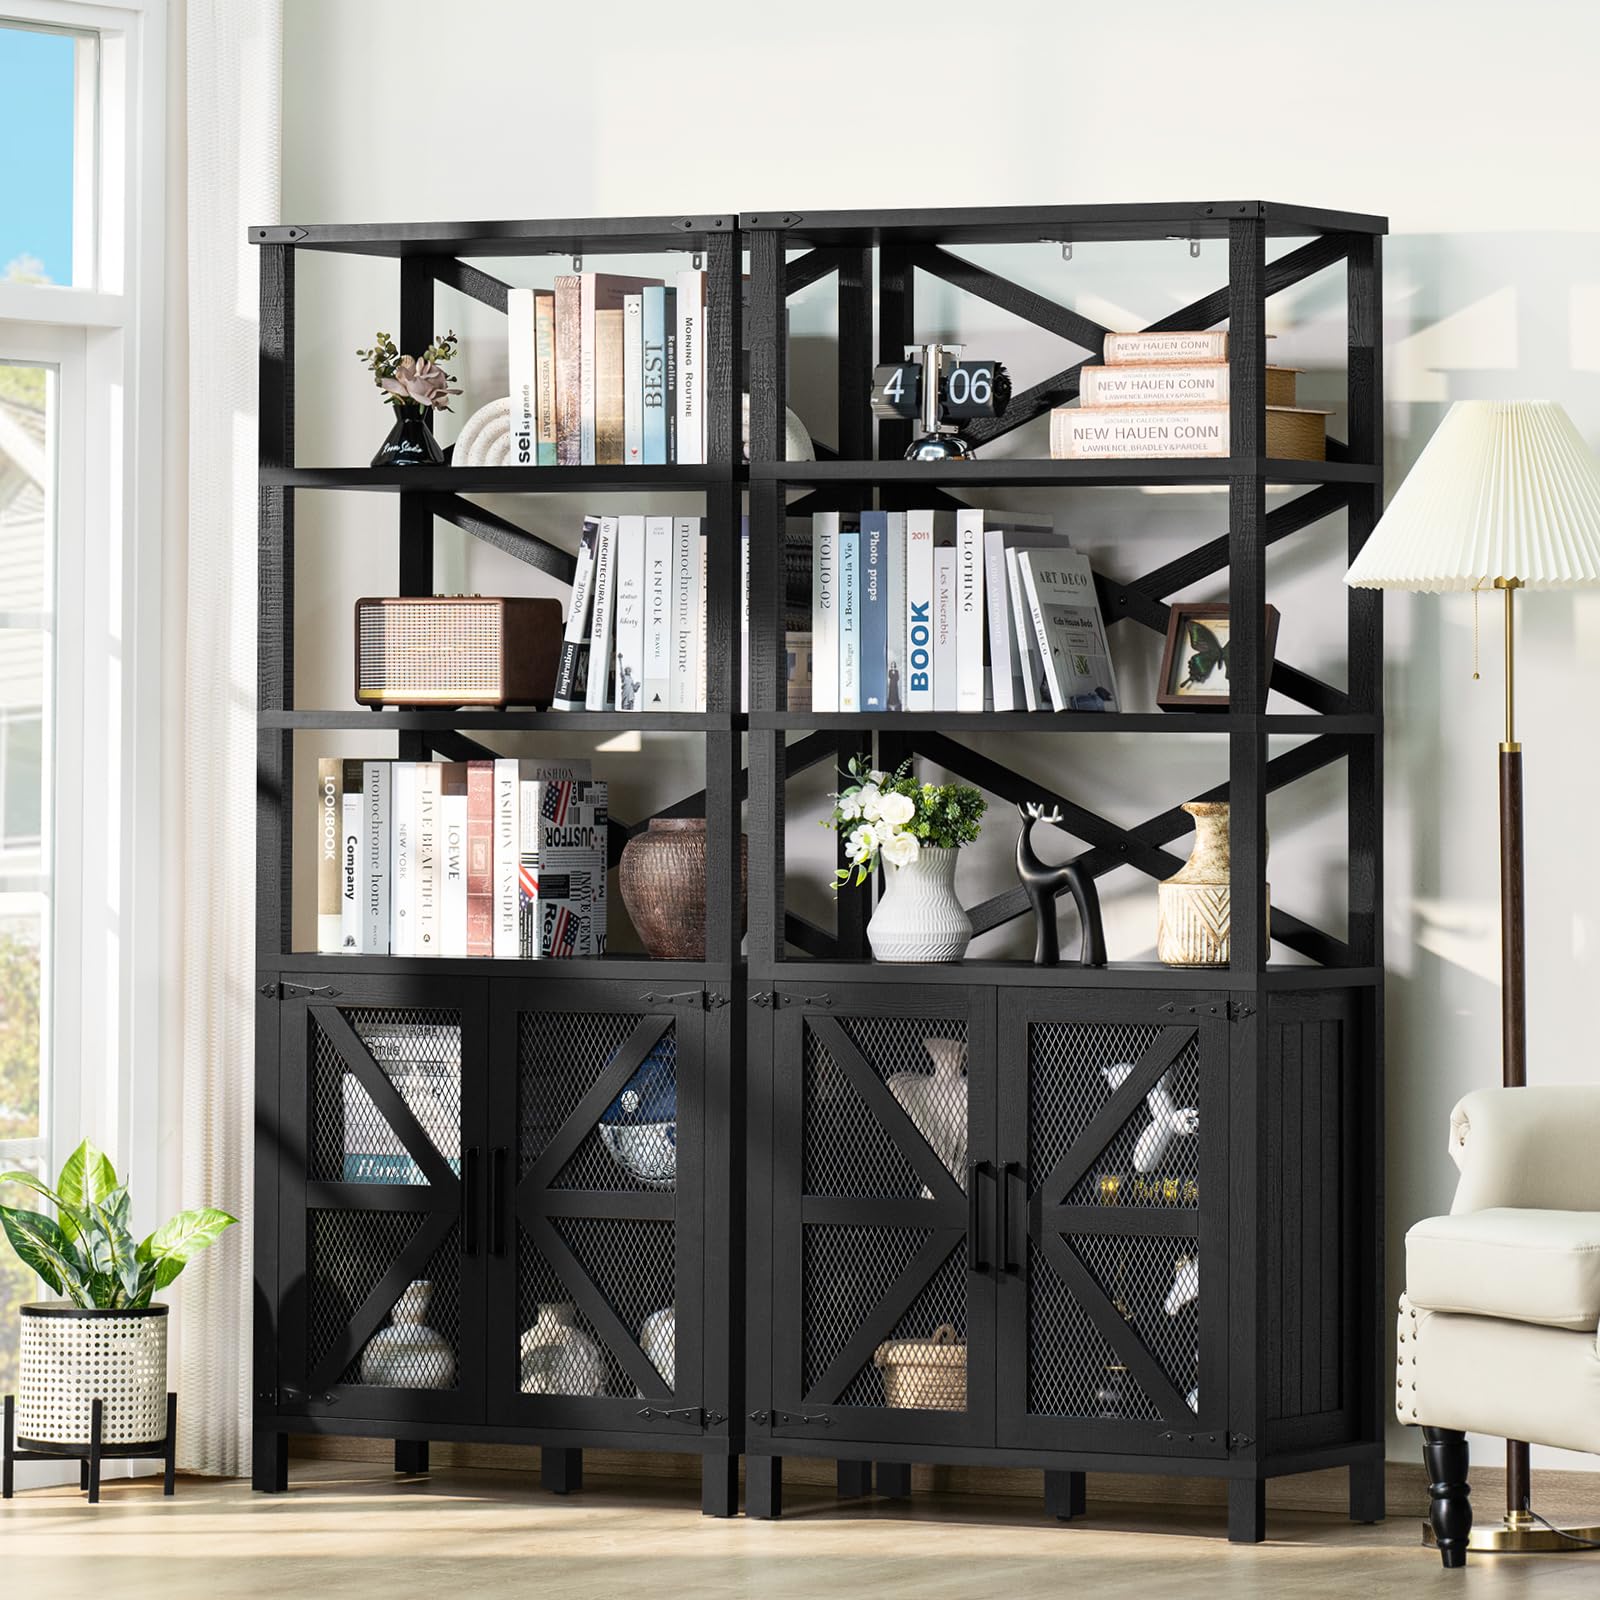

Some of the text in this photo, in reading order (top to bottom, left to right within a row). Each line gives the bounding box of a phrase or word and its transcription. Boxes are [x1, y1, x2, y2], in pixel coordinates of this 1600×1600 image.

[685, 317, 693, 417] MORNING ROUTINE
[1117, 343, 1141, 351] NEW
[1180, 341, 1209, 349] CONN
[645, 341, 663, 408] BEST
[883, 368, 905, 403] 4
[949, 368, 992, 404] 06
[1097, 381, 1128, 391] NEW
[1178, 379, 1215, 389] CONN
[522, 384, 532, 418] grande
[515, 432, 530, 463] sei
[1074, 428, 1110, 440] NEW
[1174, 425, 1219, 438] CONN
[845, 542, 853, 560] Vie
[912, 532, 930, 540] 2011
[597, 536, 609, 606] ARCHITECTURAL
[680, 524, 692, 625] monochrome
[820, 534, 831, 609] FOLIO-02
[845, 562, 853, 572] la
[846, 574, 853, 587] ou
[868, 531, 879, 601] Photo props
[964, 530, 973, 612] CLOTHING
[1039, 571, 1088, 587] ART DECO
[574, 581, 587, 614] VOGUE
[654, 560, 663, 625] KINFOLK
[845, 590, 853, 615] Boxe
[940, 567, 949, 645] Les Miserables
[595, 608, 604, 639] DIGEST
[845, 618, 853, 632] La
[679, 630, 691, 673] home
[911, 601, 929, 691] BOOK
[558, 644, 574, 696] inspiration
[537, 768, 574, 780] FASHION
[325, 776, 336, 860] LOOKBOOK
[371, 769, 382, 869] monochrome
[500, 780, 512, 849] FASHION
[345, 835, 358, 900] Company
[448, 825, 460, 880] LOEWE
[371, 874, 383, 916] home
